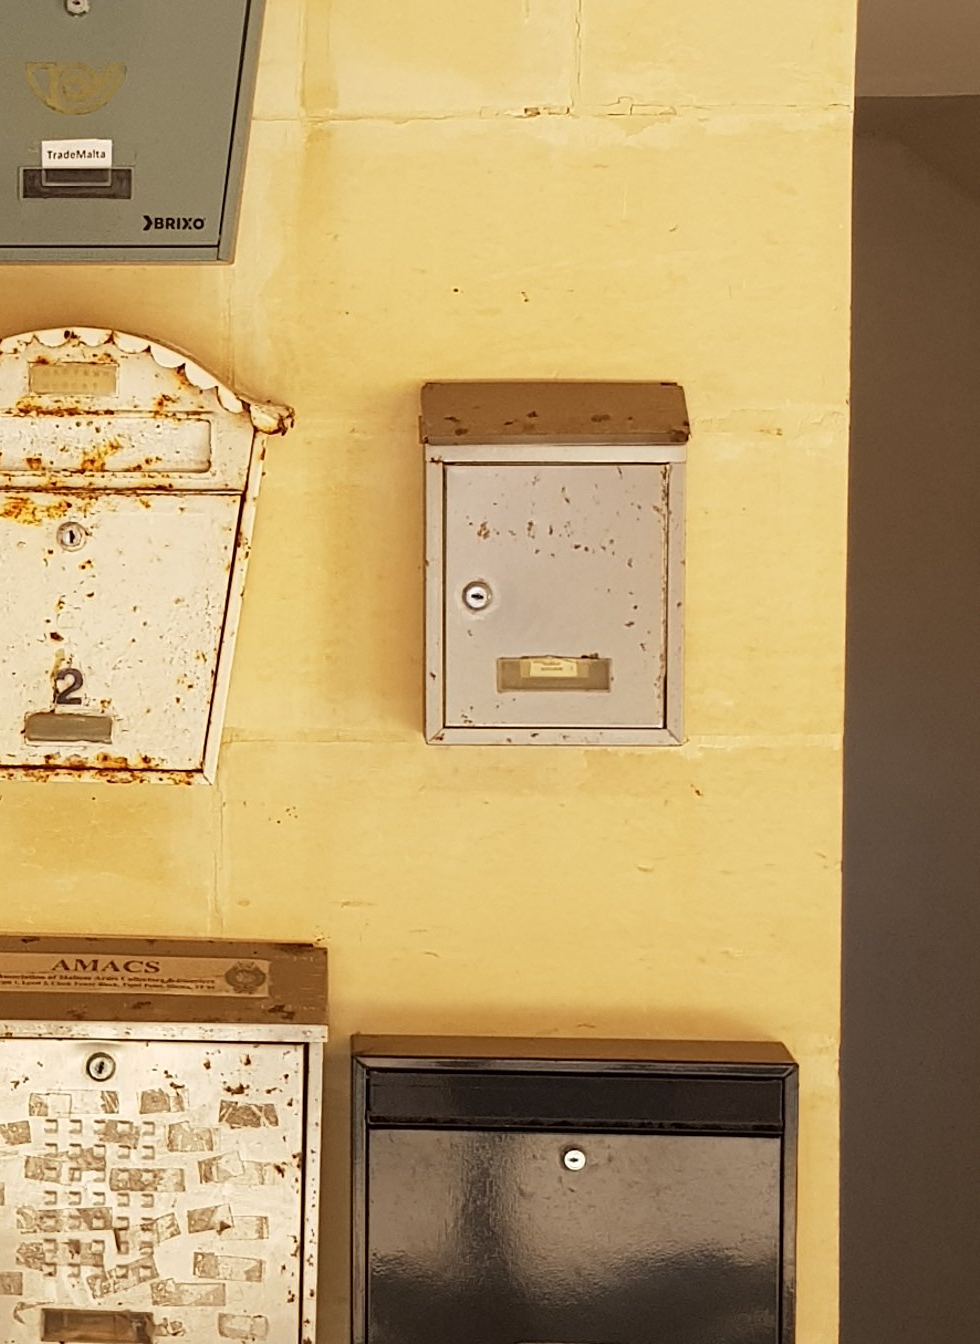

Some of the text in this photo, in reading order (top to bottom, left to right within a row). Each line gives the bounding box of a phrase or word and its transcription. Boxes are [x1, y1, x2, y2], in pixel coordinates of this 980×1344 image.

[46, 149, 106, 160] TradeMalta
[154, 217, 205, 230] BRIXO
[55, 667, 84, 705] 2
[51, 958, 161, 974] AMACS
